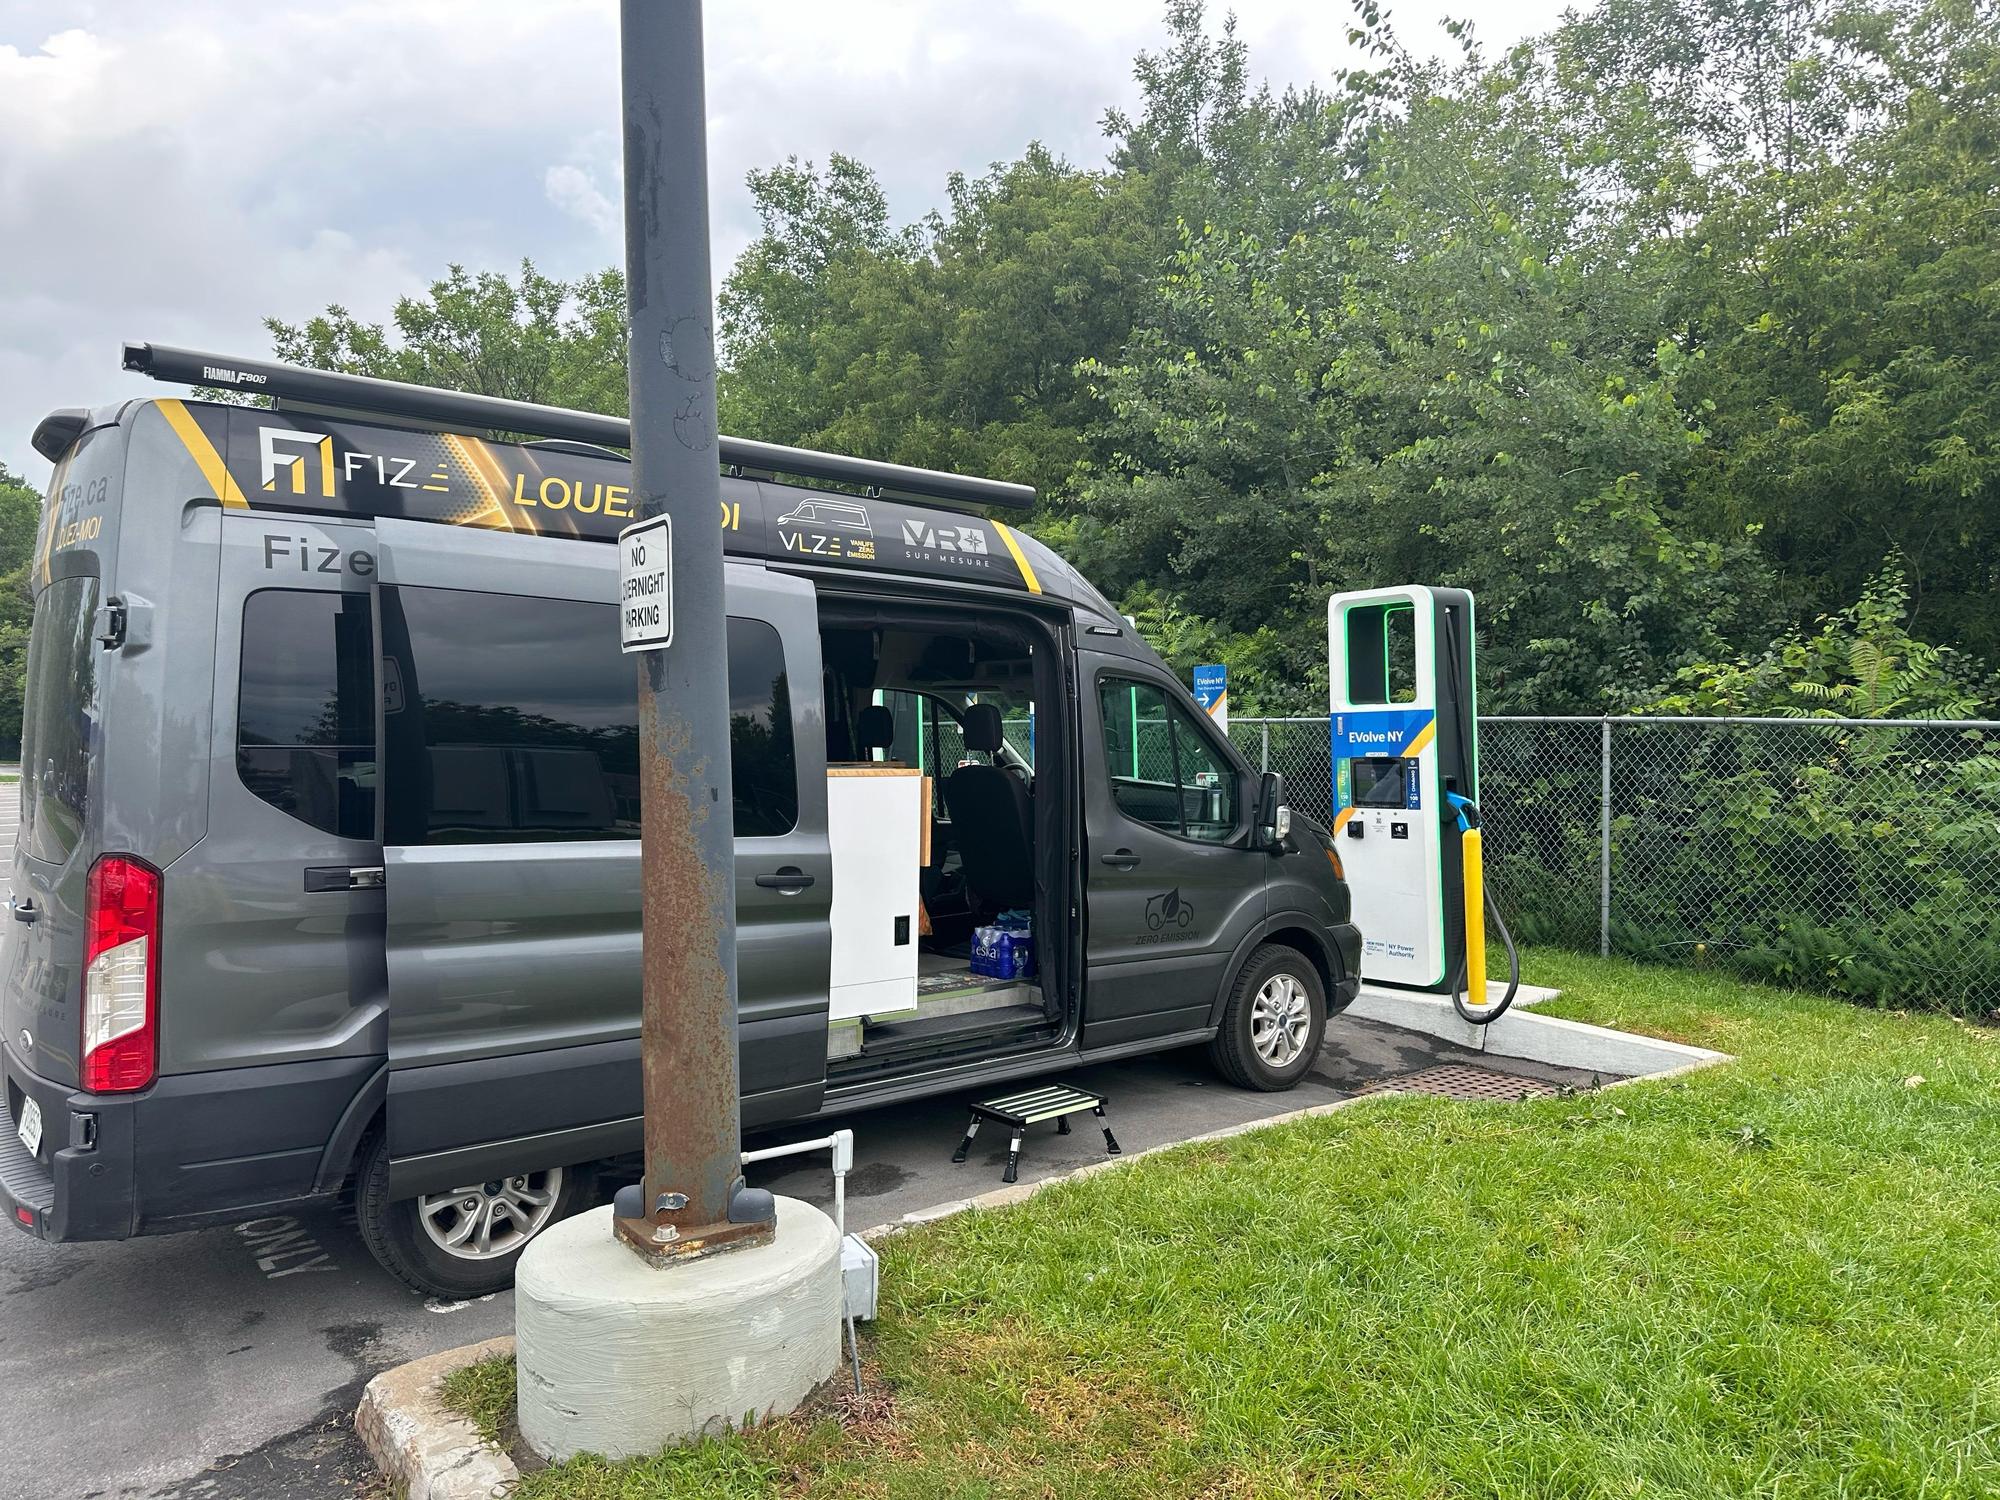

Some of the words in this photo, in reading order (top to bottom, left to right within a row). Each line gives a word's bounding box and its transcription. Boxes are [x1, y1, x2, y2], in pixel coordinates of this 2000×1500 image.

[203, 366, 236, 383] FIAMMA
[850, 540, 875, 548] VANLIFE
[858, 546, 875, 554] ZERO
[264, 534, 374, 576] Fize
[631, 545, 646, 567] NO
[905, 551, 930, 560] SUR
[939, 555, 990, 568] MESURE
[625, 604, 660, 629] PARKING
[1197, 678, 1215, 686] EVolve
[1349, 731, 1386, 743] EVolve
[1387, 731, 1404, 742] NY
[1135, 935, 1159, 945] ZERO
[1160, 931, 1200, 943] EMISSION
[1388, 950, 1414, 959] Authority
[233, 1216, 340, 1279] ONLY
